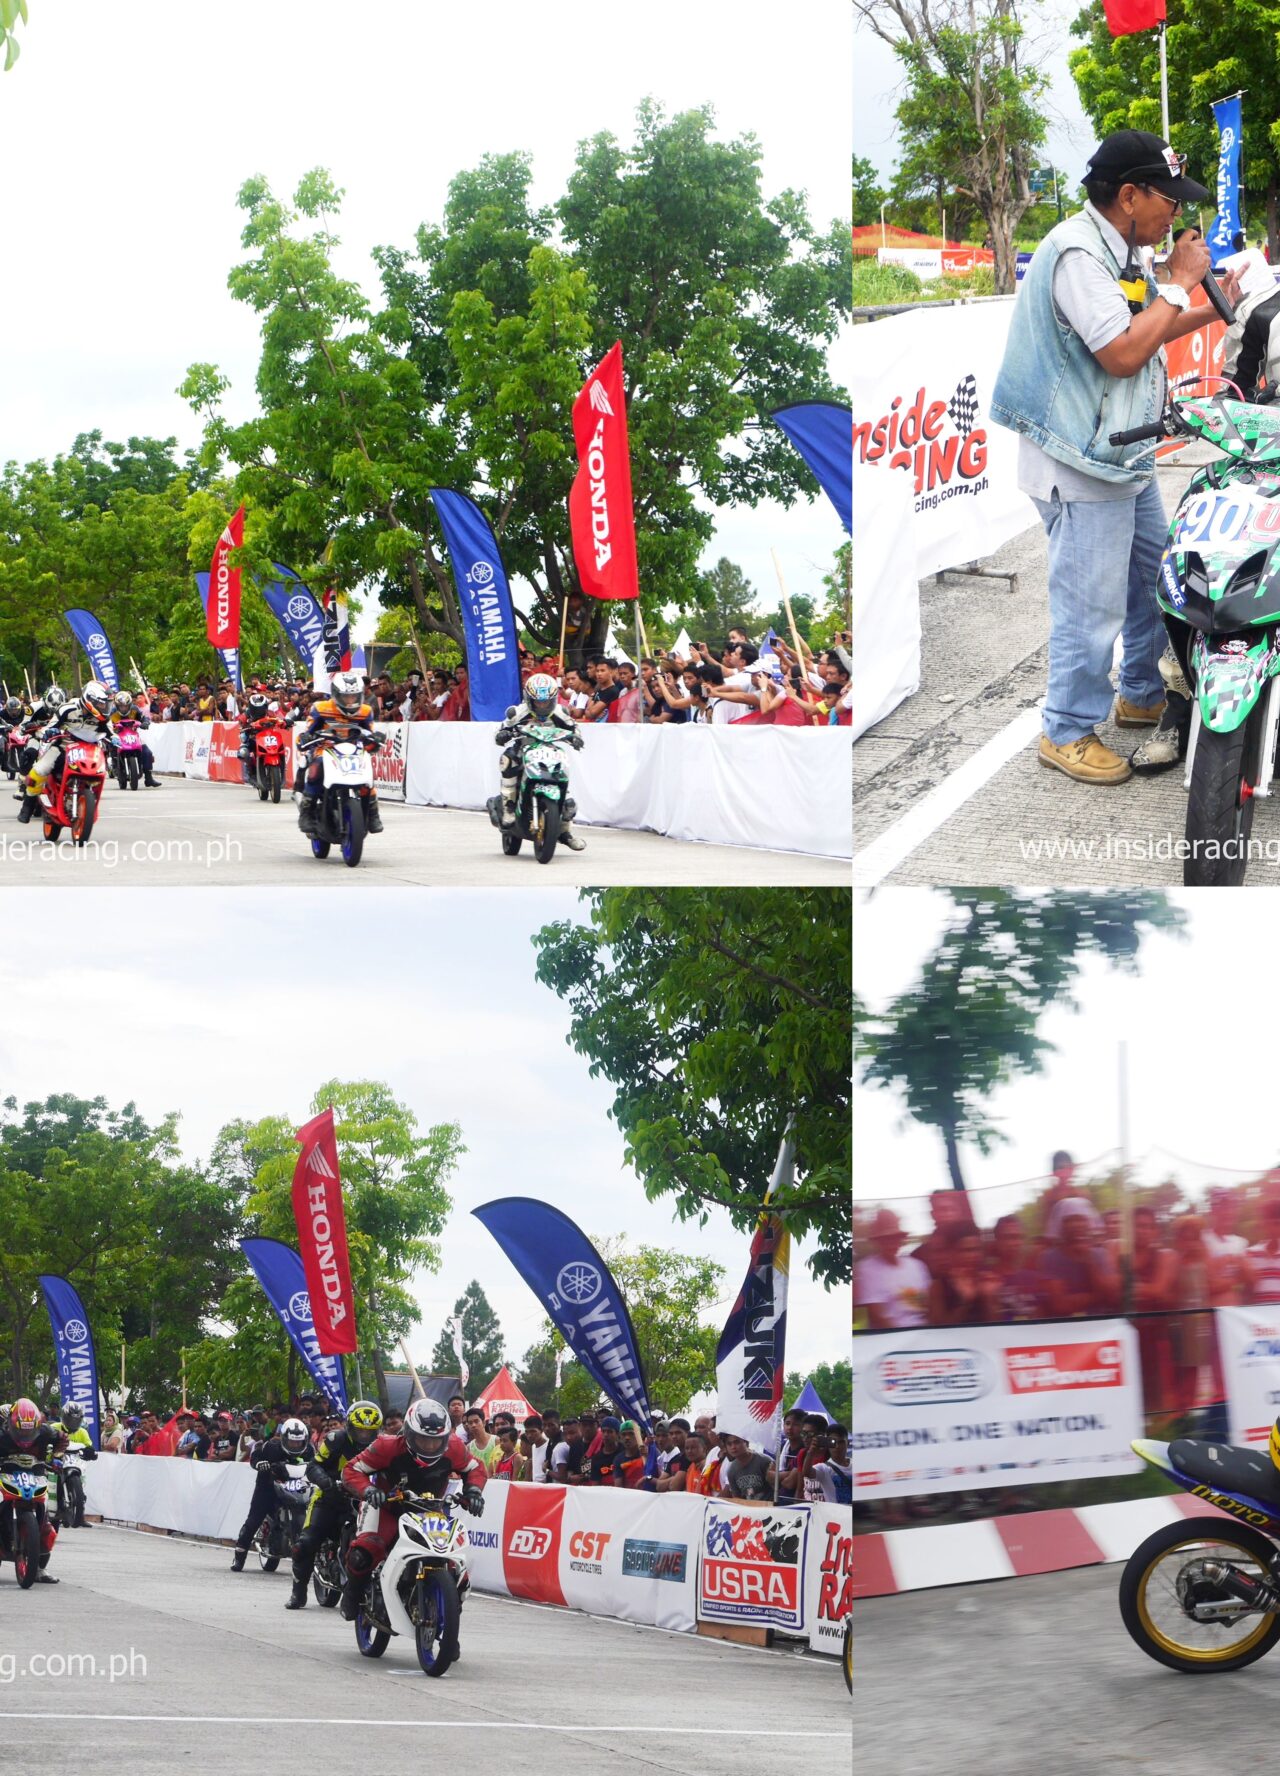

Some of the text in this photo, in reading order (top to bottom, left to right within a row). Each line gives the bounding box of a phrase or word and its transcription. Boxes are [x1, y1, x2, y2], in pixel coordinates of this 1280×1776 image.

[1180, 495, 1250, 542] 90
[217, 548, 229, 634] HONDA
[1163, 563, 1186, 606] ADVANCE
[322, 594, 341, 673] ZUKI
[477, 583, 506, 664] YAMAHA
[94, 649, 119, 692] YAMA
[307, 1182, 346, 1331] HONDA
[70, 1343, 94, 1428] YAMAHA
[491, 1407, 525, 1415] RACING
[285, 1479, 301, 1491] 146
[423, 1516, 449, 1532] 172
[468, 1531, 498, 1548] SUZUKI
[508, 1526, 552, 1560] FDR
[569, 1530, 611, 1561] CST
[655, 1551, 682, 1575] LINE
[705, 1564, 790, 1606] USRA
[719, 1604, 736, 1612] SPORTS
